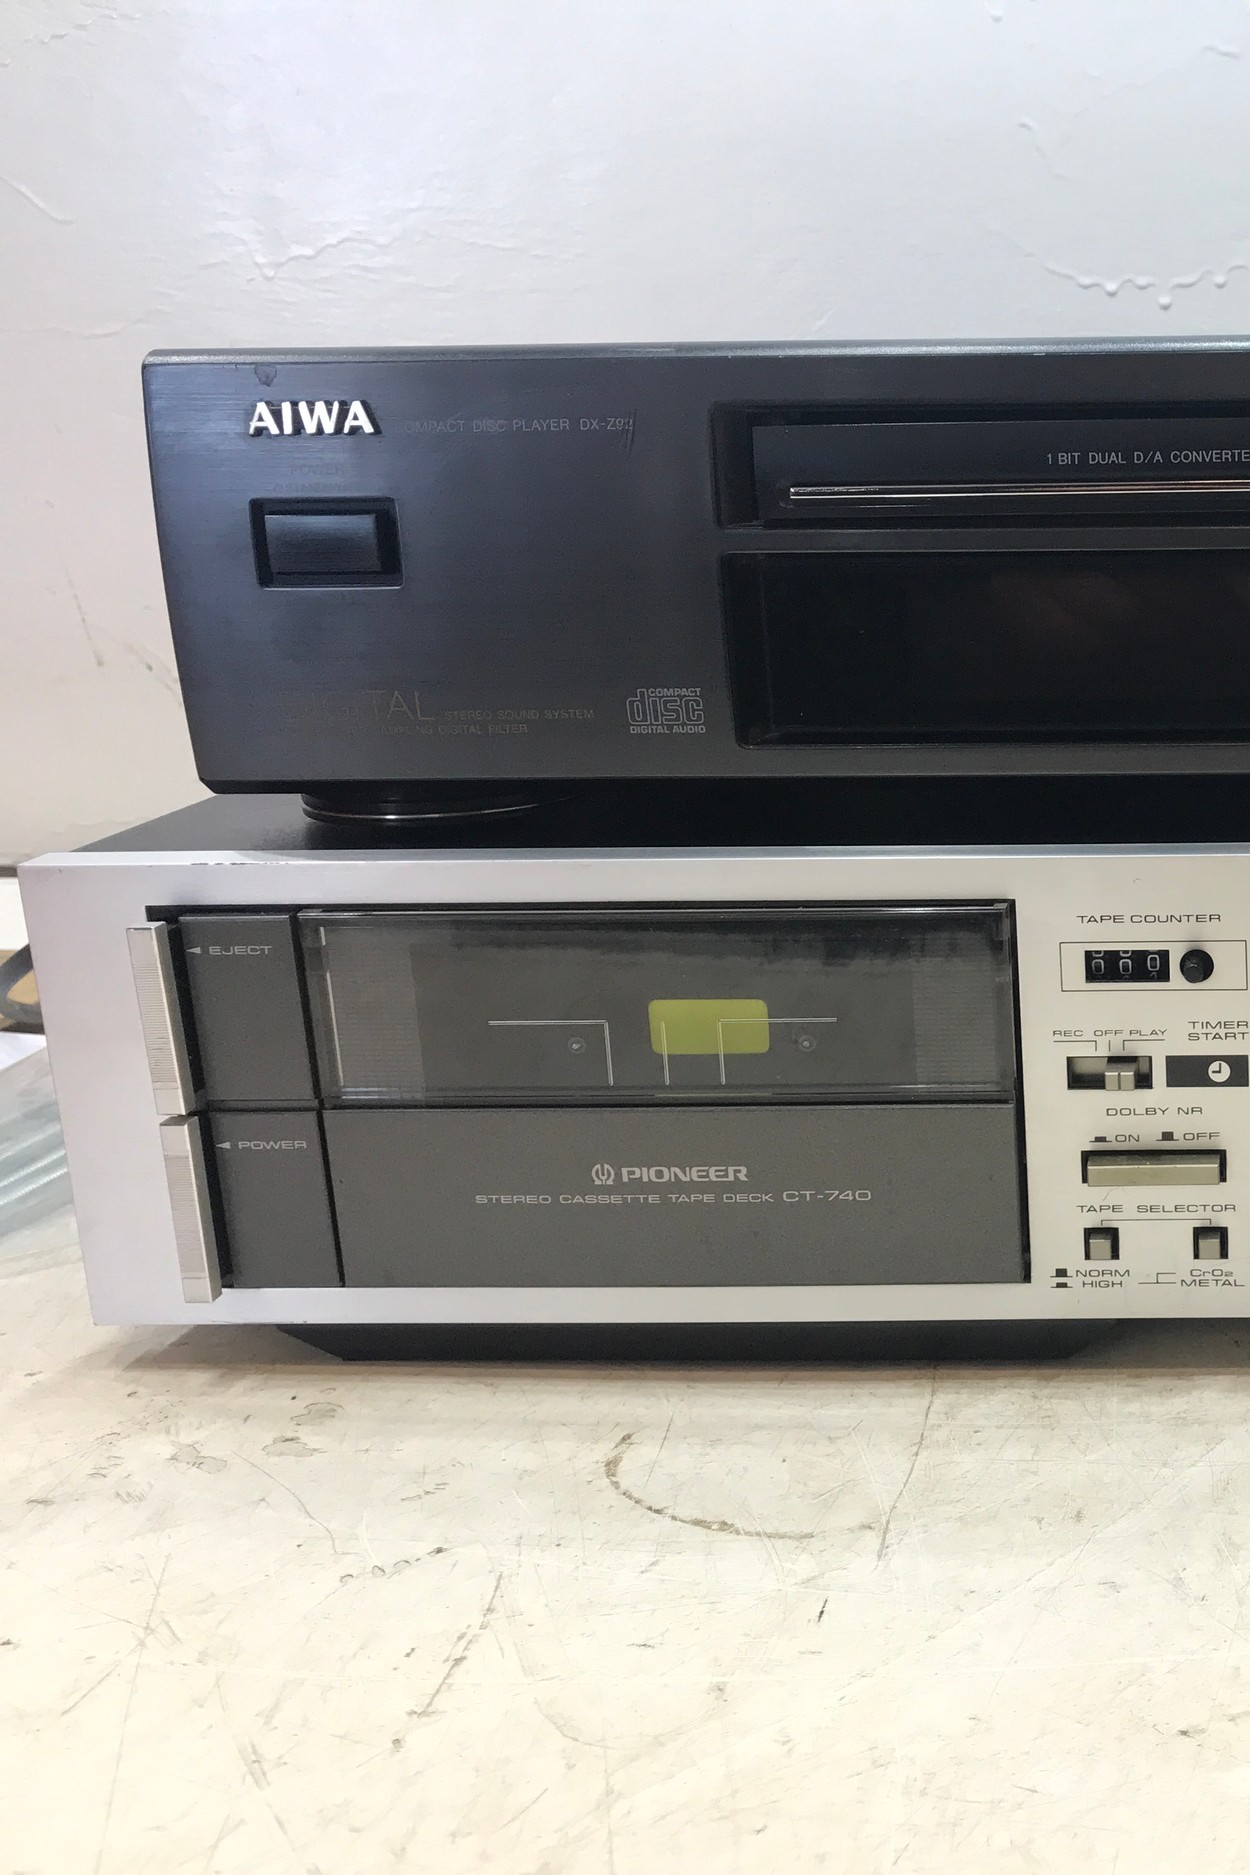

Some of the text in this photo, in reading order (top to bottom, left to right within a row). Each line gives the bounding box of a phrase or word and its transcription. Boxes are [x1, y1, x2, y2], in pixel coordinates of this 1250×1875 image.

[248, 400, 376, 436] AIWA
[513, 418, 571, 431] PLAYER
[1047, 453, 1052, 465] 1
[1057, 452, 1081, 465] BIT
[1088, 451, 1127, 465] DUAL
[1133, 450, 1164, 464] D/A
[648, 687, 701, 698] COMPACT
[498, 708, 540, 721] SOUND
[544, 708, 595, 721] SYSTEM
[629, 724, 706, 734] DIGITAL AUDIO
[1076, 913, 1222, 924] TAPE COUNTER
[208, 945, 273, 956] EJECT
[1188, 1020, 1249, 1030] TIMER
[1052, 1028, 1168, 1038] REC OFF PLAY
[1187, 1031, 1249, 1042] START
[1105, 1106, 1203, 1117] DOLBY NR
[1114, 1134, 1141, 1144] ON
[1182, 1131, 1221, 1142] OFF
[237, 1140, 308, 1150] POWER
[621, 1165, 749, 1183] PIONEER
[475, 1189, 872, 1205] STEREO CASSETTE TAPE DECK CT-740
[1077, 1203, 1236, 1214] TAPE SELECTOR
[1075, 1269, 1131, 1278] NORM
[1082, 1279, 1123, 1289] HIGH
[1180, 1278, 1245, 1288] METAL
